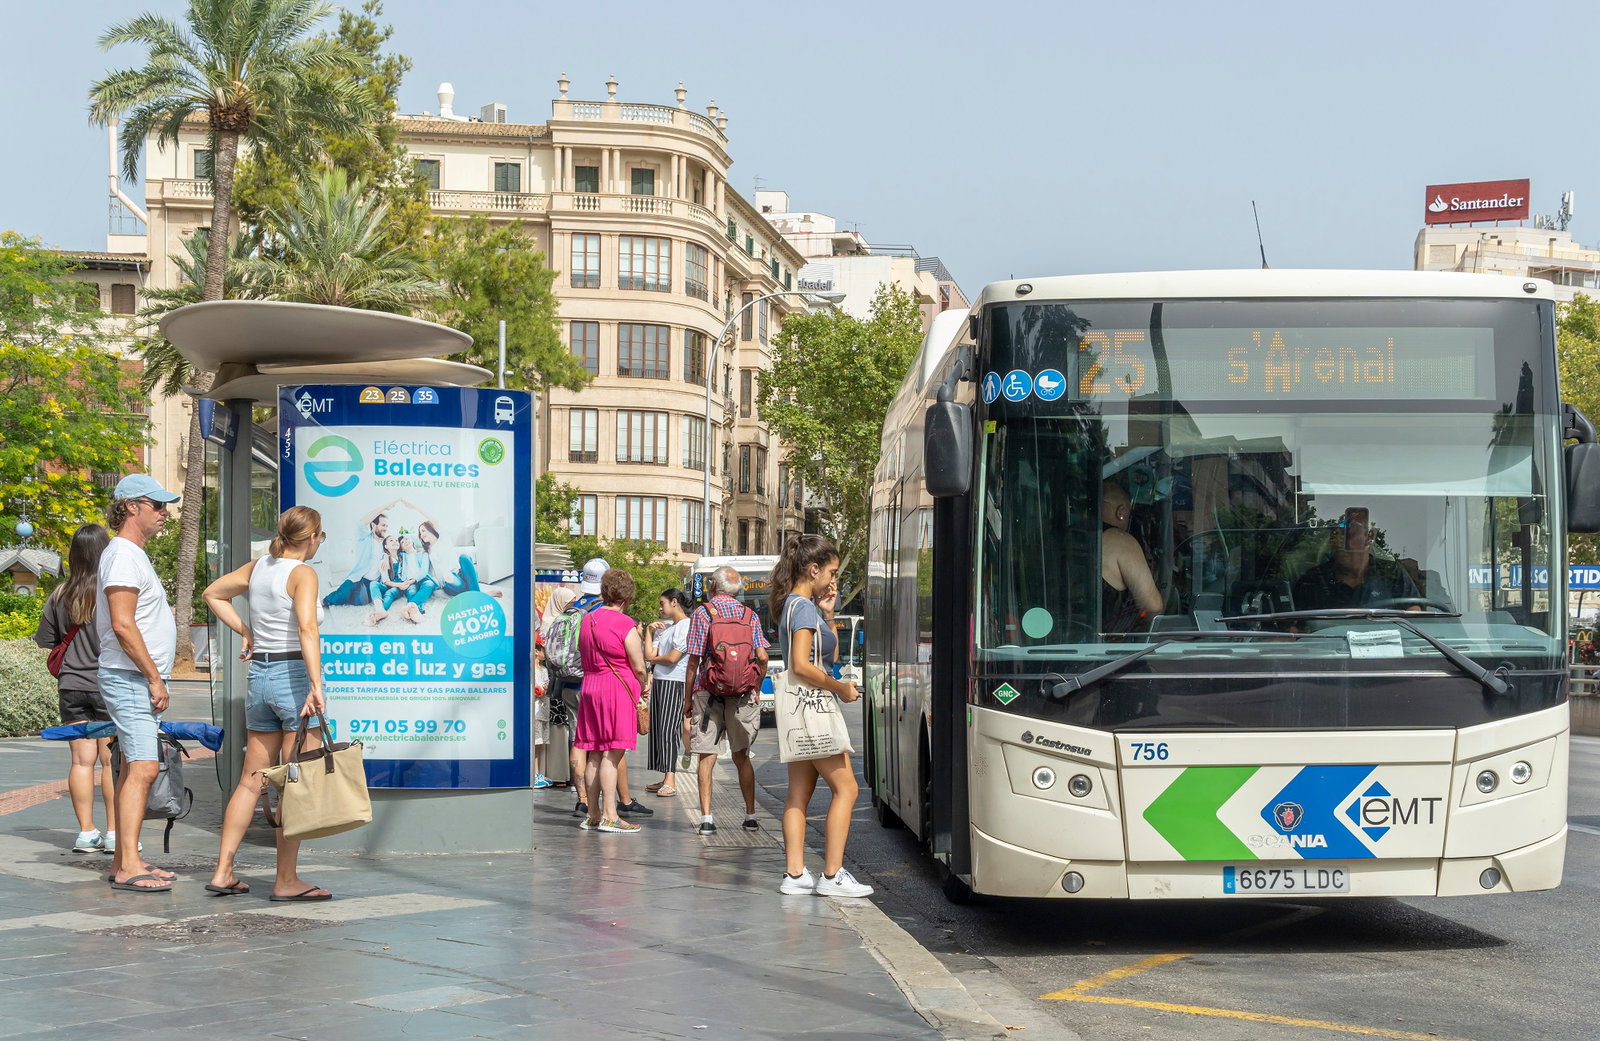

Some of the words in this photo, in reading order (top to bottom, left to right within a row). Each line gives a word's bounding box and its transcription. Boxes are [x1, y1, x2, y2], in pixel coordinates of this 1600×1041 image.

[1450, 193, 1524, 211] Santander
[797, 278, 832, 291] abadell
[1079, 330, 1145, 394] 25
[1227, 330, 1394, 393] s'Arenal
[365, 390, 380, 400] 23
[390, 391, 406, 401] 25
[418, 390, 433, 401] 35
[374, 440, 452, 456] Eléctrica
[374, 458, 480, 478] Baleares
[374, 480, 412, 488] NUESTRA
[447, 608, 479, 622] HASTA
[480, 603, 494, 613] UN
[452, 612, 499, 636] 40%
[320, 637, 374, 655] horra
[379, 641, 405, 655] en
[411, 640, 434, 655] tu
[454, 637, 466, 646] DE
[467, 628, 500, 643] AHORRO
[321, 659, 376, 676] ctura
[382, 659, 409, 676] de
[415, 659, 447, 676] luz
[452, 663, 466, 679] y
[471, 663, 507, 679] gas
[998, 689, 1014, 698] GNC
[350, 719, 379, 733] 971
[384, 719, 409, 733] 05
[414, 719, 438, 733] 99
[443, 719, 467, 734] 70
[350, 734, 467, 742] www.electricabaleares.es
[1035, 735, 1092, 756] Castrosua
[1130, 742, 1169, 761] 756
[1247, 834, 1328, 848] SCANIA
[1240, 869, 1295, 890] 6675
[1303, 869, 1344, 889] LDC
